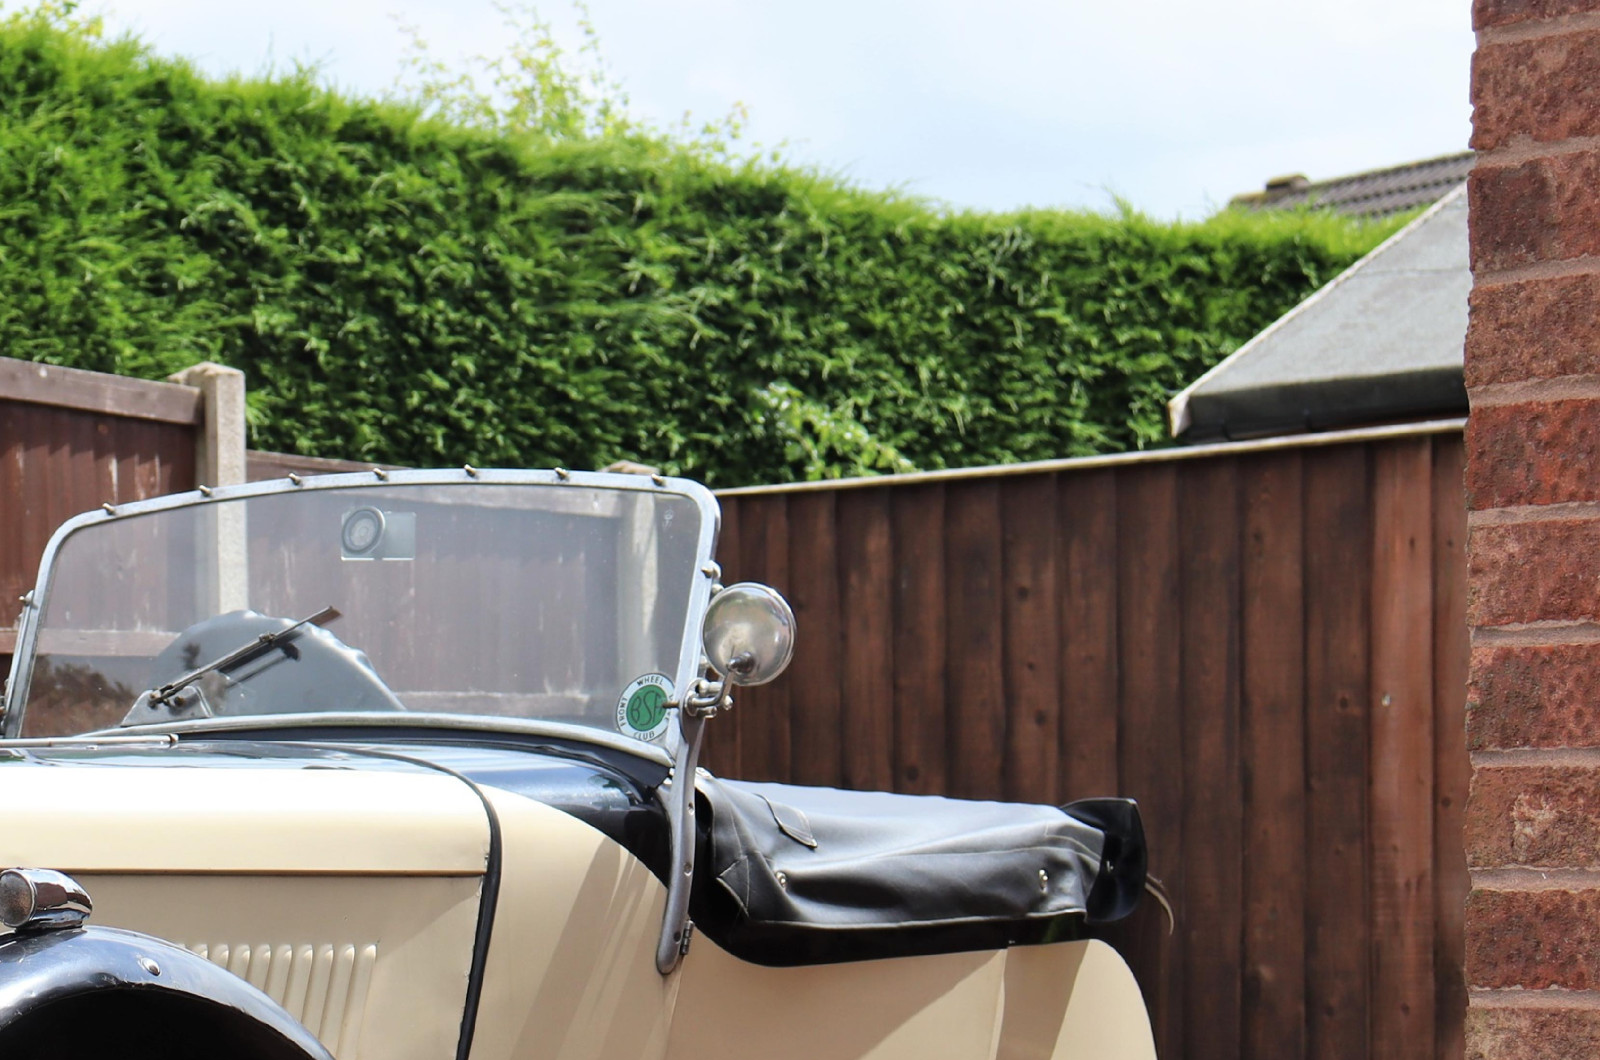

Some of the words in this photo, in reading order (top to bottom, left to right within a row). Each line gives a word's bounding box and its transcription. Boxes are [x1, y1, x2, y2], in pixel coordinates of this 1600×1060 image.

[636, 675, 664, 686] WHEEL
[618, 696, 628, 727] FRONT
[633, 730, 655, 741] CLUB
